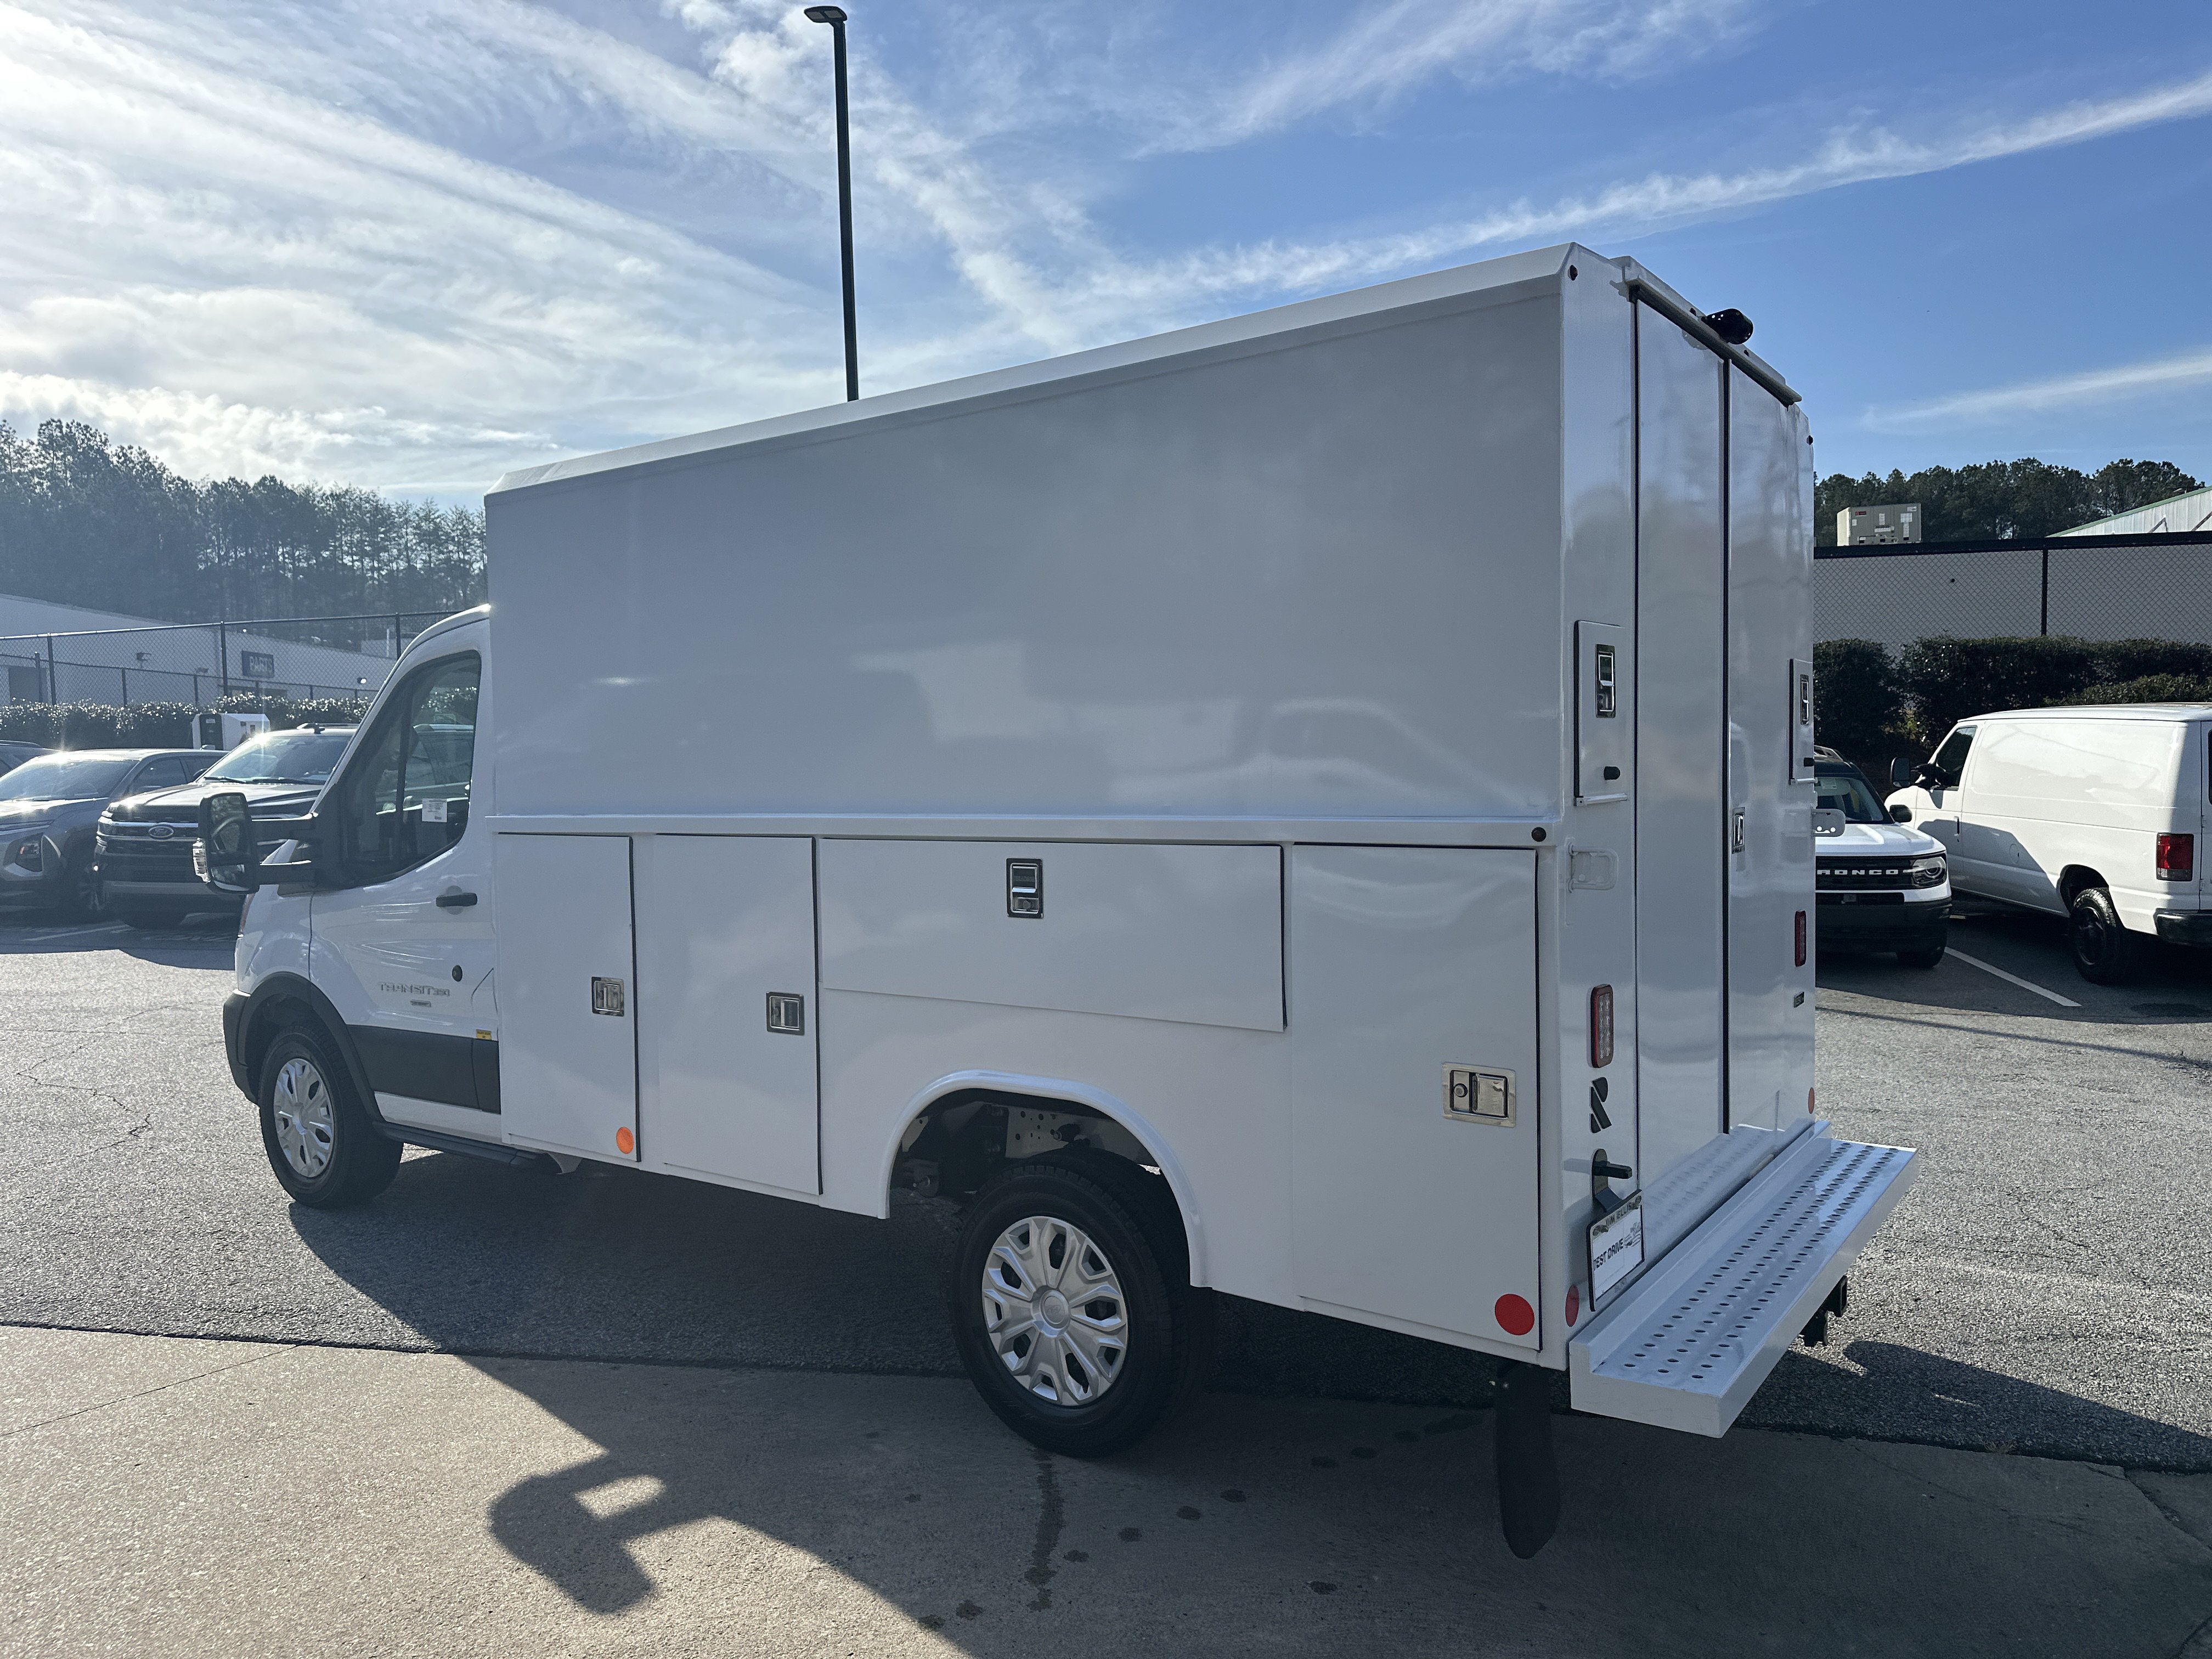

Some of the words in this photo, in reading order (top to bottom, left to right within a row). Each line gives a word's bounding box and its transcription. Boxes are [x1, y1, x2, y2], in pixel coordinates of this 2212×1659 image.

[250, 656, 273, 673] PARTS
[378, 982, 433, 995] TRANSIT
[1593, 1250, 1607, 1271] TEST
[1607, 1238, 1623, 1260] DRIVE
